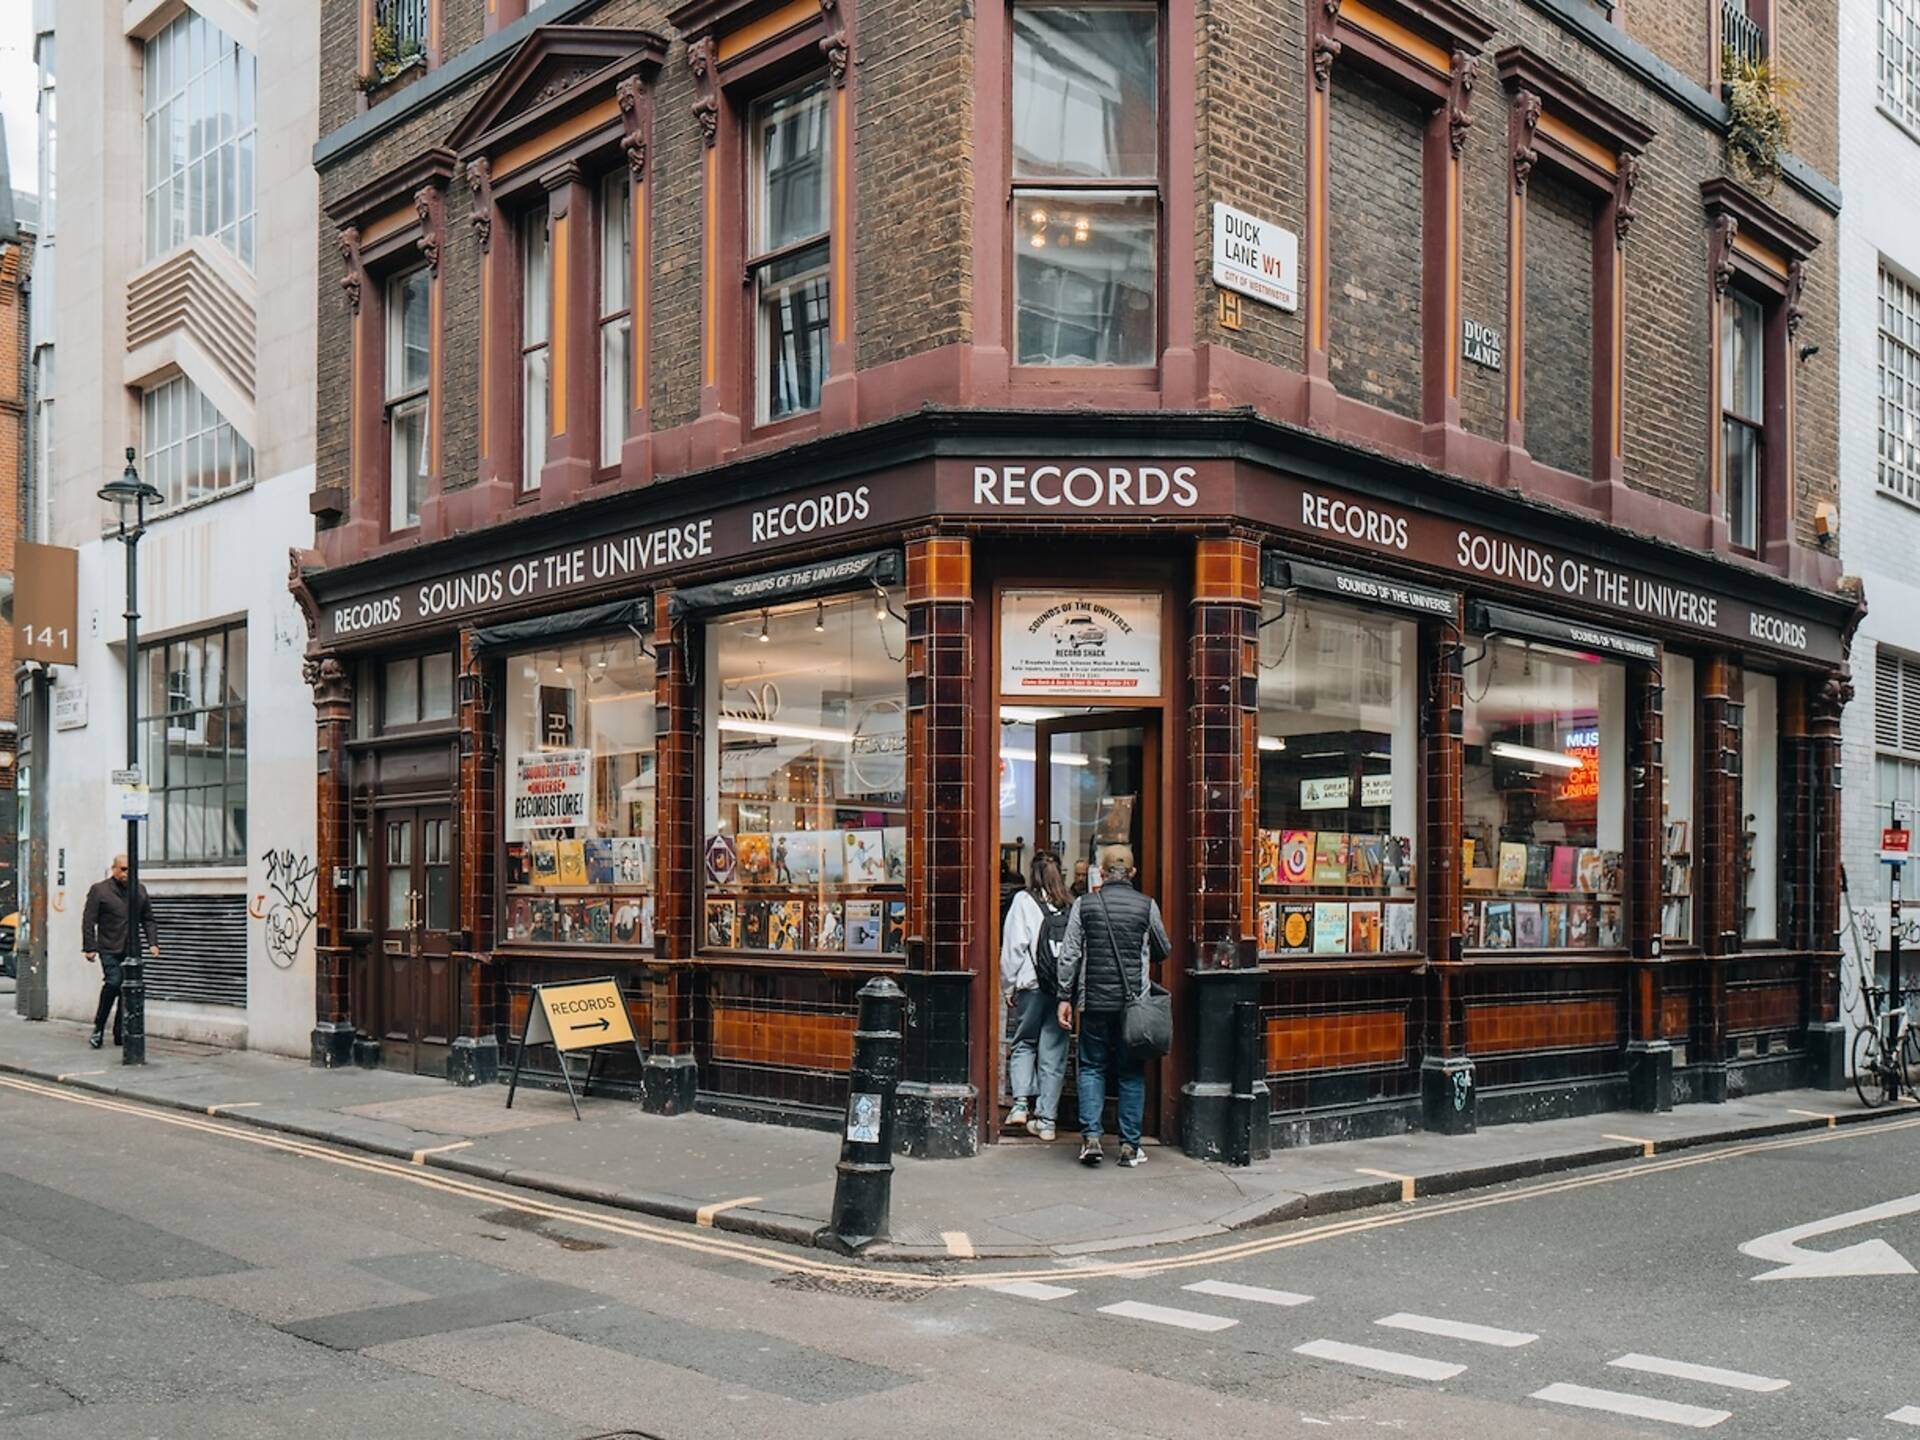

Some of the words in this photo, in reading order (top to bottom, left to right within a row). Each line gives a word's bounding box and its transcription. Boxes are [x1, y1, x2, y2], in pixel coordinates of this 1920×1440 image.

[1225, 214, 1261, 247] DUCK
[1225, 239, 1258, 270] LANE
[1262, 253, 1283, 279] W1
[1224, 271, 1238, 282] CITY
[1240, 277, 1248, 286] OF
[1249, 280, 1290, 303] WESTMINSTER
[1464, 320, 1500, 349] DUCK
[1463, 340, 1500, 369] LANE
[974, 466, 1198, 507] RECORDS
[334, 596, 401, 634] RECORDS
[418, 569, 503, 617] SOUNDS
[508, 560, 540, 596] OF
[544, 549, 585, 589] THE
[592, 519, 713, 578] UNIVERSE
[752, 486, 870, 543] RECORDS
[1302, 491, 1408, 550] RECORDS
[1457, 531, 1554, 588] SOUNDS
[1560, 559, 1589, 596] OF
[1594, 568, 1629, 606] THE
[1634, 579, 1717, 628] UNIVERSE
[1750, 612, 1806, 650] RECORDS
[732, 579, 775, 596] SOUNDS
[776, 575, 791, 589] OF
[791, 570, 811, 586] THE
[812, 558, 869, 582] UNIVERSE
[1336, 576, 1377, 597] SOUNDS
[1378, 585, 1390, 599] OF
[1391, 588, 1409, 604] THE
[1409, 592, 1452, 613] UNIVERSE
[1028, 606, 1061, 634] SOUNDS
[1061, 602, 1073, 613] OF
[1075, 601, 1092, 611] THE
[1093, 604, 1134, 635] UNIVERSE
[21, 623, 69, 649] 141
[1570, 628, 1600, 645] SOUNDS
[1600, 635, 1610, 647] OF
[1610, 637, 1624, 650] THE
[1624, 641, 1656, 658] UNIVERSE
[1055, 649, 1082, 657] RECORD
[1083, 649, 1106, 657] SHACK
[1323, 783, 1346, 791] GREAT
[551, 996, 616, 1016] RECORDS
